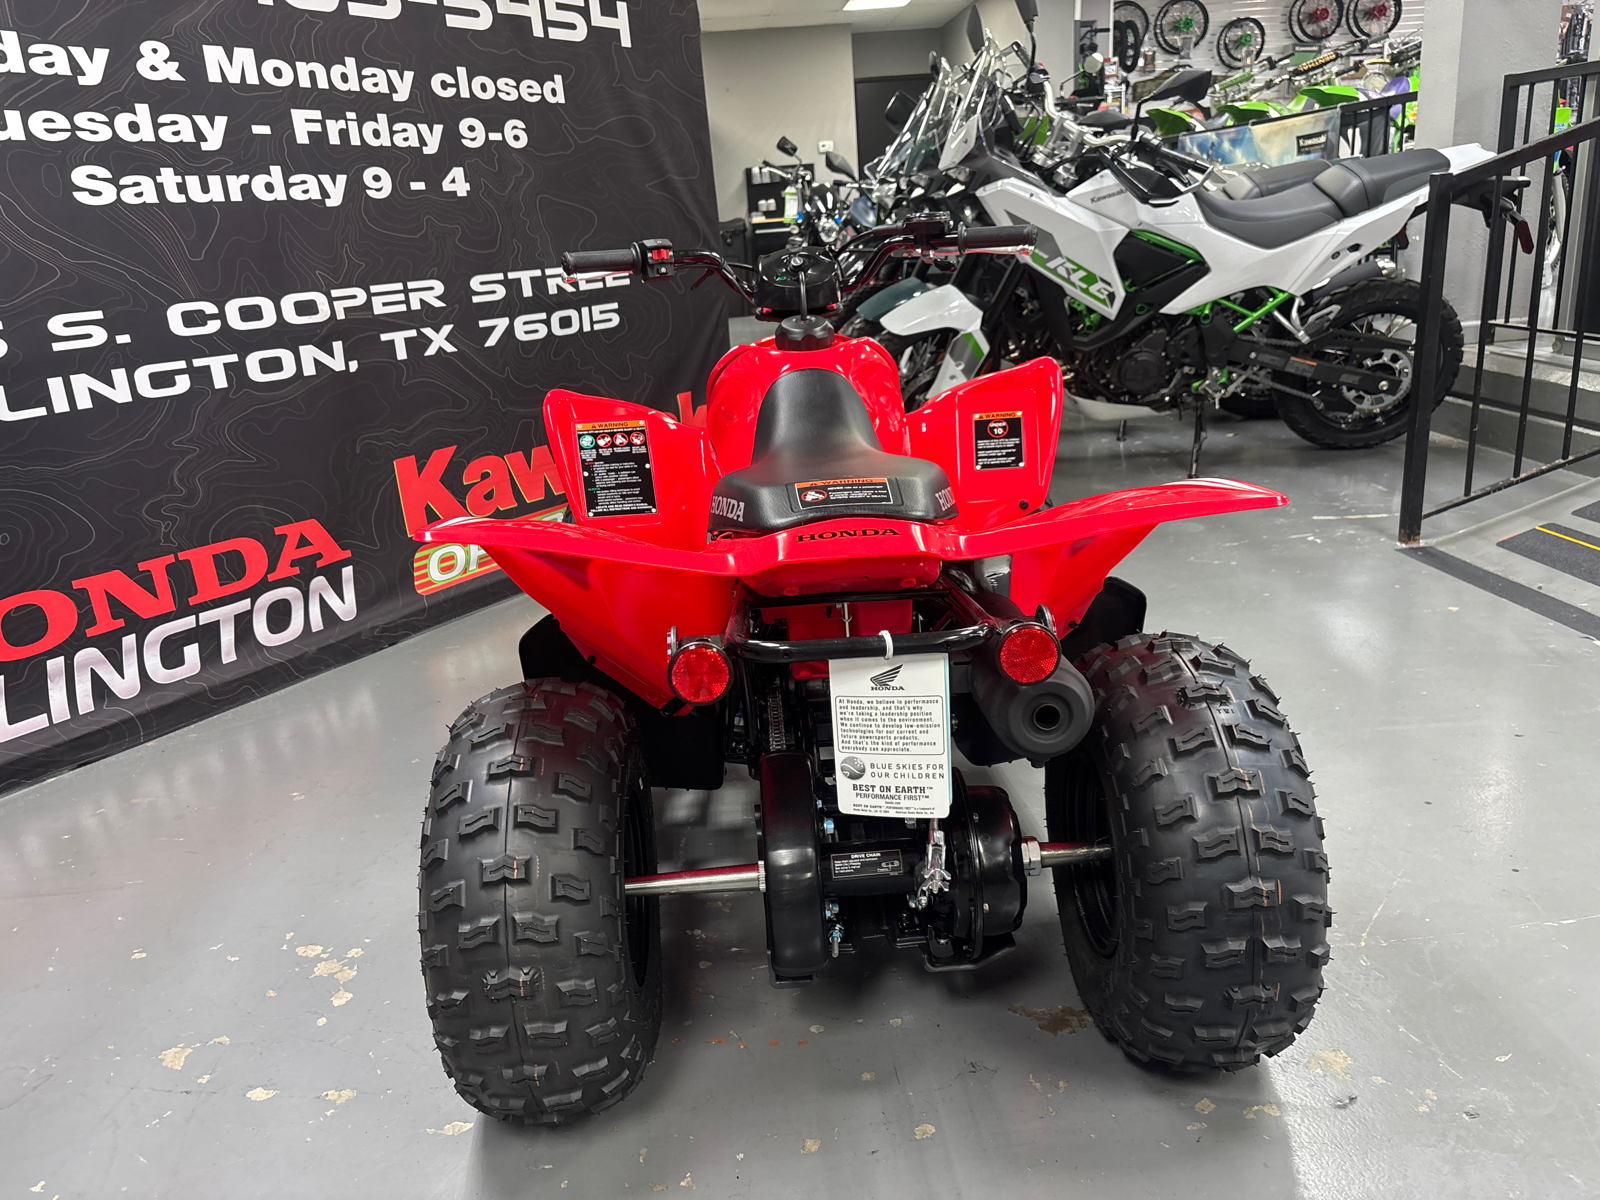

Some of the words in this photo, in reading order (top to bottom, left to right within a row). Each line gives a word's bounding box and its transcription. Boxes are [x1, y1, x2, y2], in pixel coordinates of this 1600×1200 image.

[135, 40, 186, 82] &
[203, 45, 414, 101] Monday
[431, 66, 565, 104] closed
[251, 125, 272, 134] -
[291, 108, 444, 155] Friday
[459, 119, 529, 149] 9-6
[72, 164, 347, 207] Saturday
[364, 167, 392, 199] 9
[410, 181, 426, 190] -
[441, 167, 470, 197] 4
[47, 310, 131, 352] S.
[166, 278, 446, 338] COOPER
[381, 323, 458, 361] TX
[479, 303, 620, 348] 76015
[710, 495, 745, 522] HONDA
[796, 529, 902, 543] HONDA
[0, 566, 357, 742] LINGTON
[852, 784, 876, 792] BEST
[879, 785, 891, 793] ON
[896, 763, 923, 771] SKIES
[926, 763, 944, 771] FOR
[855, 792, 902, 800] PERFORMANCE
